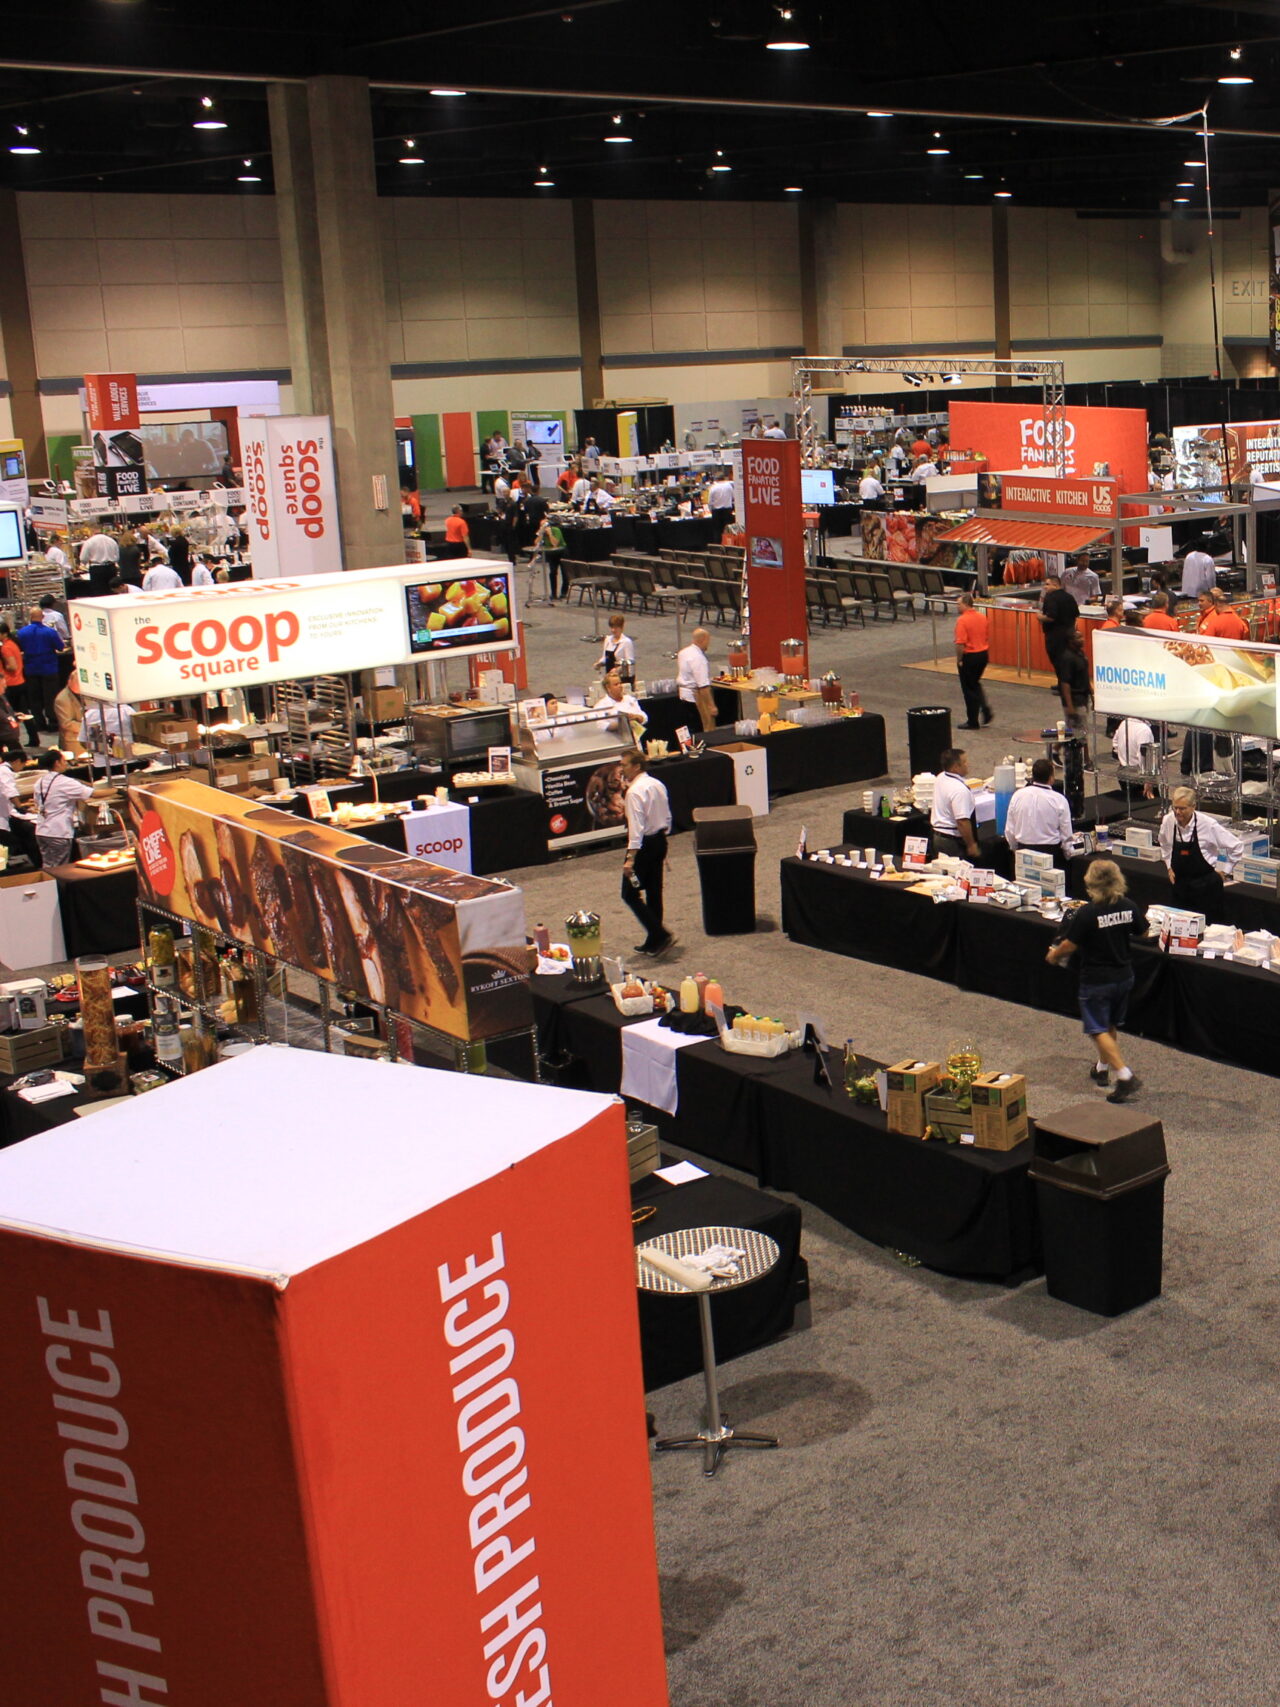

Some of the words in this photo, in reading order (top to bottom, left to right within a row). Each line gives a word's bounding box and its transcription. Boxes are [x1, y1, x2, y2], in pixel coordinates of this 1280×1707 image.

[1232, 280, 1265, 297] EXIT
[109, 382, 119, 402] ADDED
[120, 387, 130, 416] SERVICES
[112, 403, 121, 421] VALUE
[1020, 418, 1076, 447] FOOD
[116, 471, 139, 480] FOOD
[746, 457, 780, 475] FOOD
[117, 484, 140, 493] LIVE
[245, 444, 257, 514] square
[278, 445, 299, 515] square
[748, 474, 780, 486] FANATICS
[252, 440, 270, 541] scoop
[296, 440, 325, 539] scoop
[749, 486, 781, 506] LIVE
[1006, 486, 1051, 503] INTERACTIVE
[1056, 490, 1088, 506] KITCHEN
[1093, 504, 1111, 512] FOODS
[134, 615, 151, 625] the
[308, 612, 343, 622] EXCLUSIVE
[344, 607, 384, 618] INNOVATION
[308, 622, 327, 631] FROM
[328, 620, 343, 629] OUR
[135, 610, 301, 665] scoop
[180, 657, 260, 684] square
[1096, 665, 1166, 690] MONOGRAM
[145, 848, 162, 865] LINE
[415, 837, 463, 856] scoop
[1097, 909, 1134, 928] BACKLINE
[470, 981, 499, 993] RYKOFF
[438, 1231, 537, 1594] PRODUCE
[36, 1295, 163, 1653] PRODUCE
[481, 1575, 553, 1707] ESH
